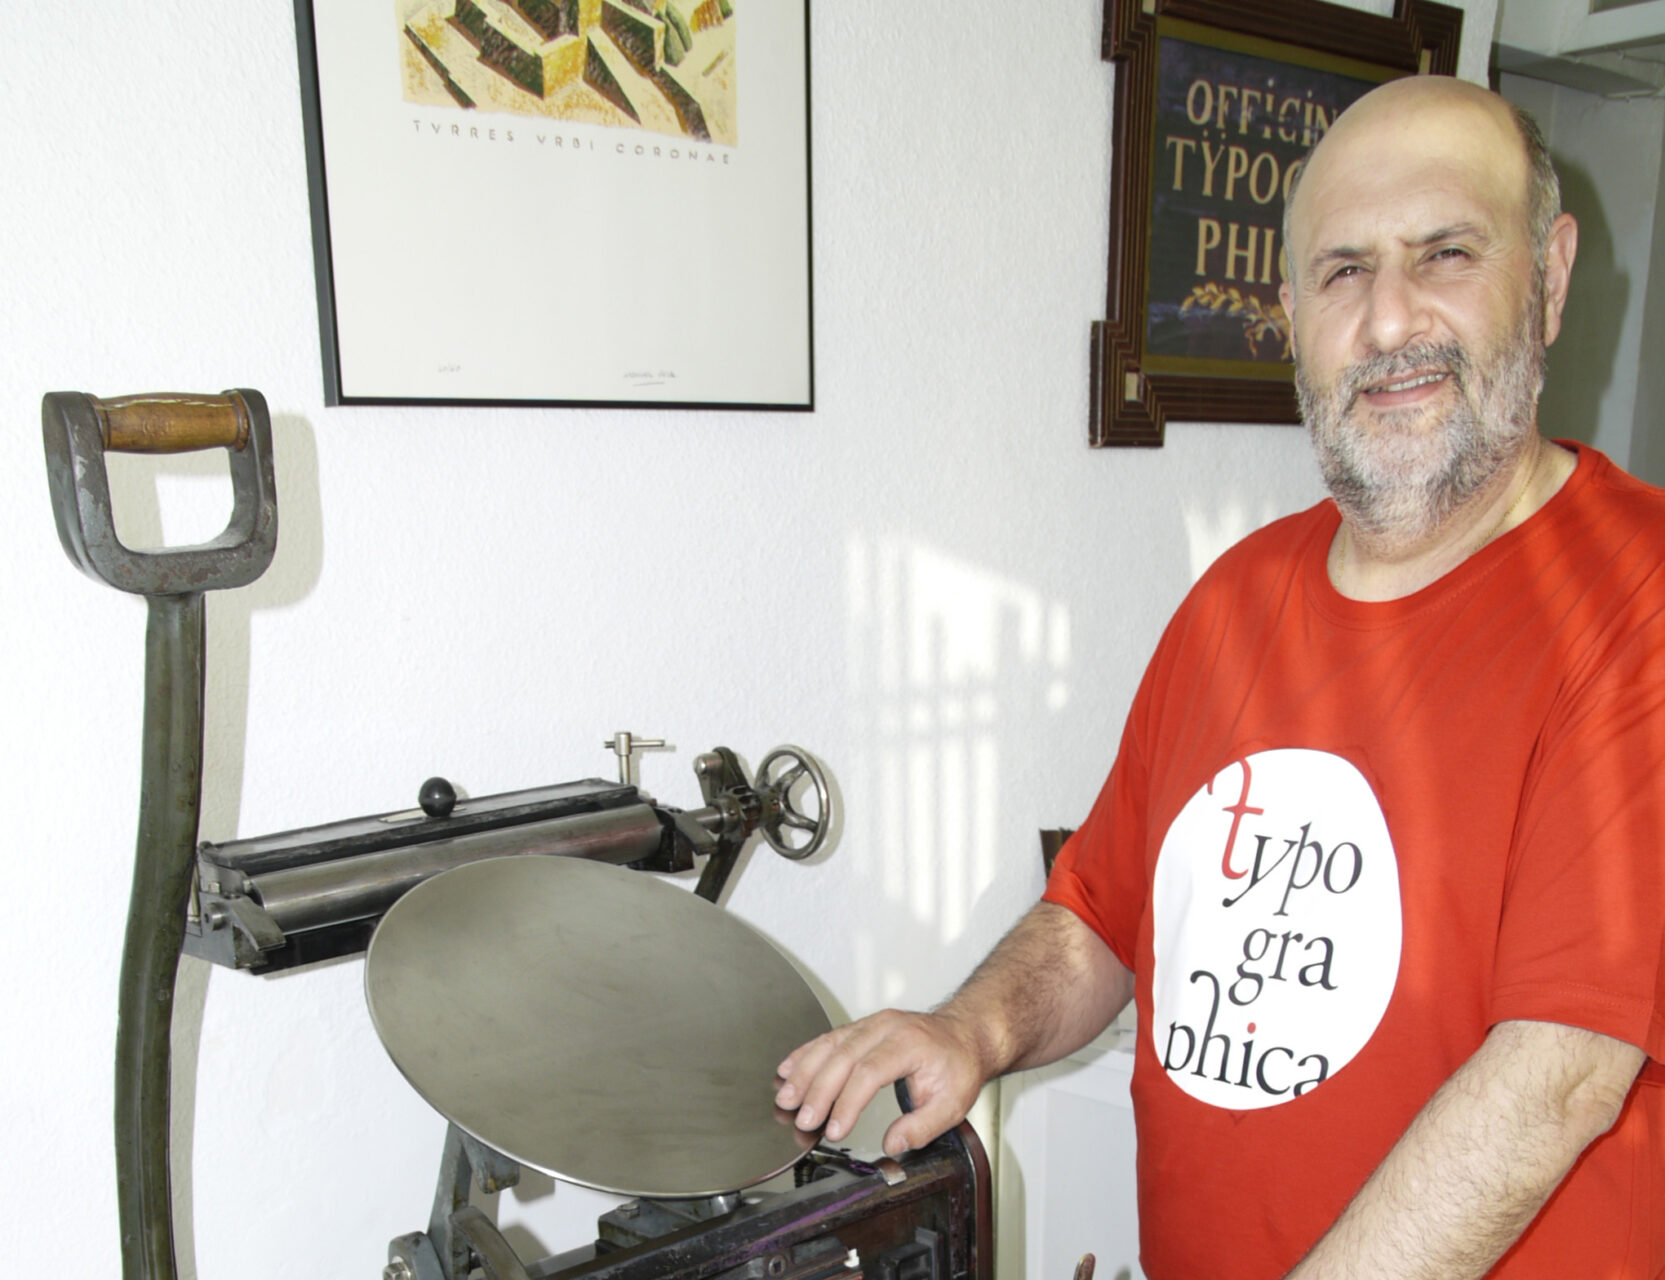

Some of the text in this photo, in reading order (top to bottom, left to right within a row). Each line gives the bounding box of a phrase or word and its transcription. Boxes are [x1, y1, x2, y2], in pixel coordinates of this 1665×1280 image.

[413, 119, 729, 165] TVRRES VRBI CORONAE
[1195, 217, 1291, 285] PHI
[1228, 928, 1338, 1006] gra
